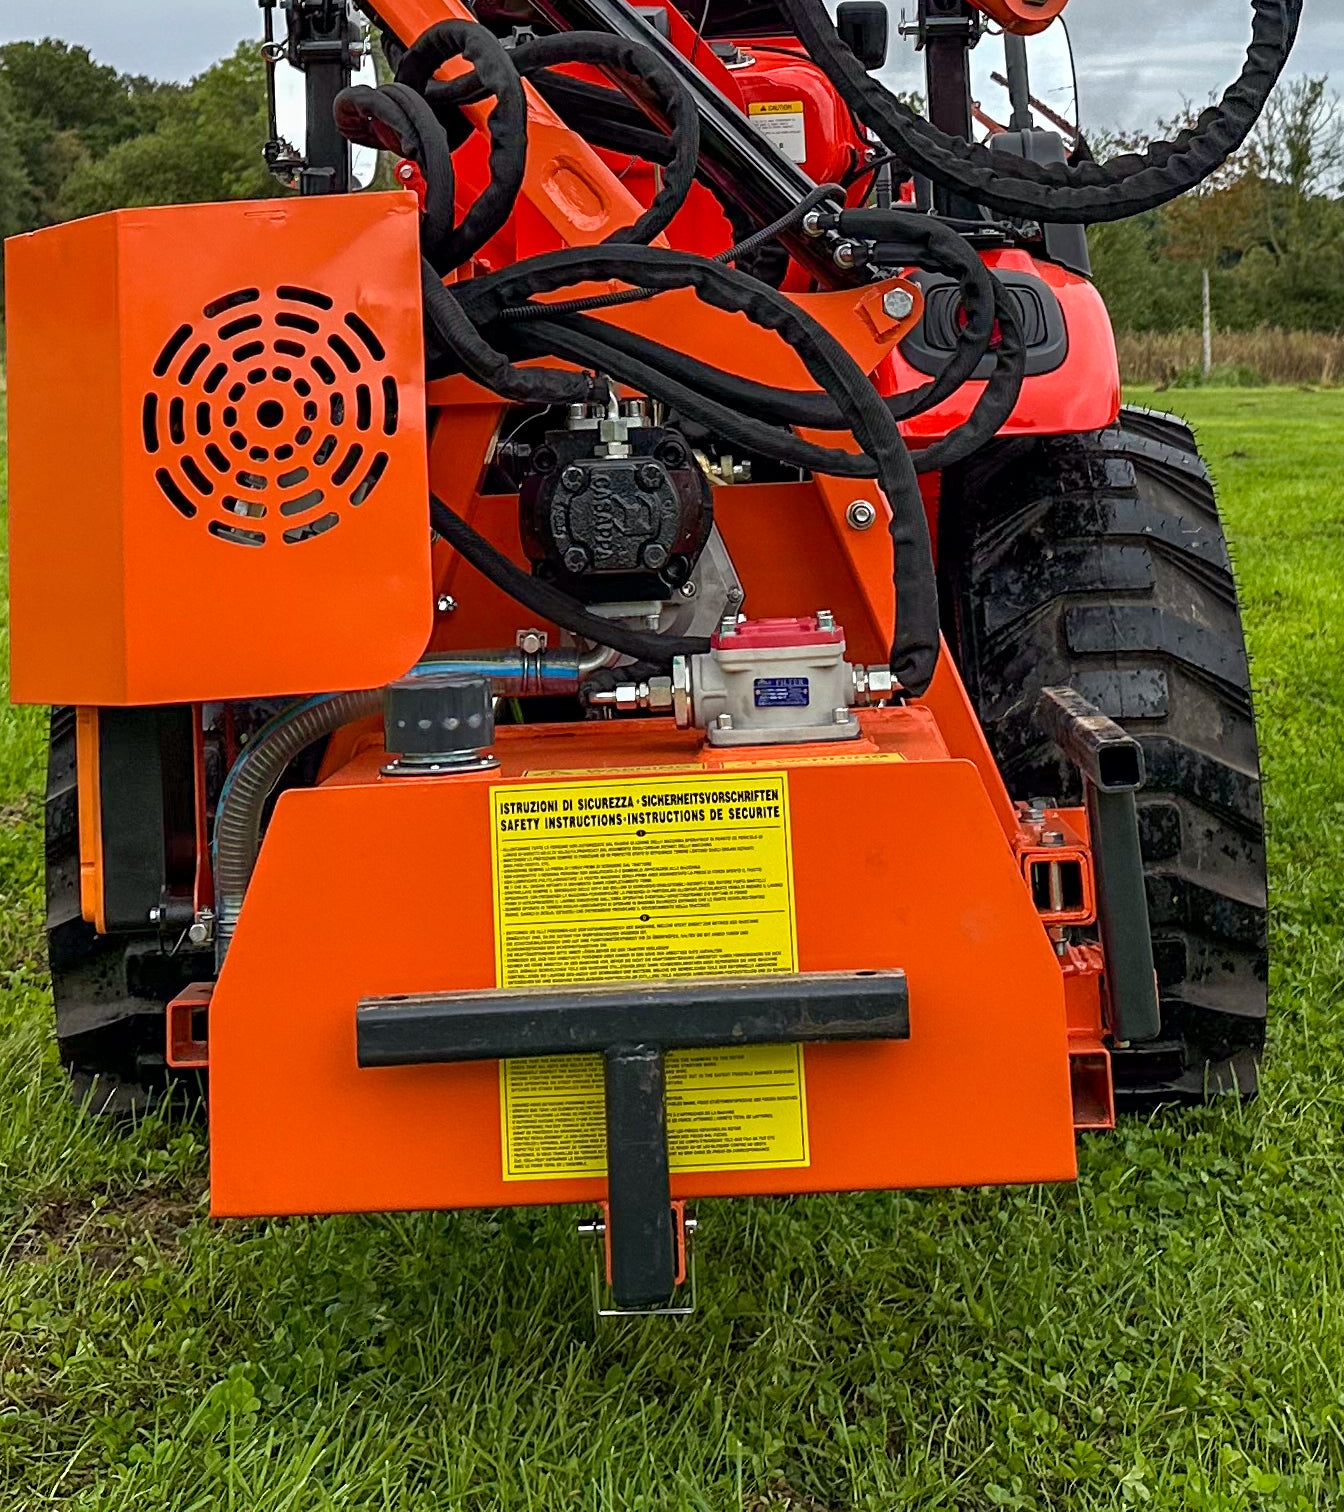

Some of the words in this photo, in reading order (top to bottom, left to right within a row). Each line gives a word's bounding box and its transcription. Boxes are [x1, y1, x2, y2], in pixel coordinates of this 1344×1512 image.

[591, 473, 614, 561] CASAPPA
[500, 799, 558, 815] ISTRUZIONI
[562, 798, 573, 812] DI
[577, 795, 634, 811] SICUREZZA
[641, 788, 779, 807] SICHERHEITSVORSCHRIFTEN
[500, 817, 540, 832] SAFETY
[544, 813, 623, 829] INSTRUCTIONS
[627, 808, 705, 825] INSTRUCTIONS
[709, 808, 723, 821] DE
[728, 805, 780, 820] SECURITE
